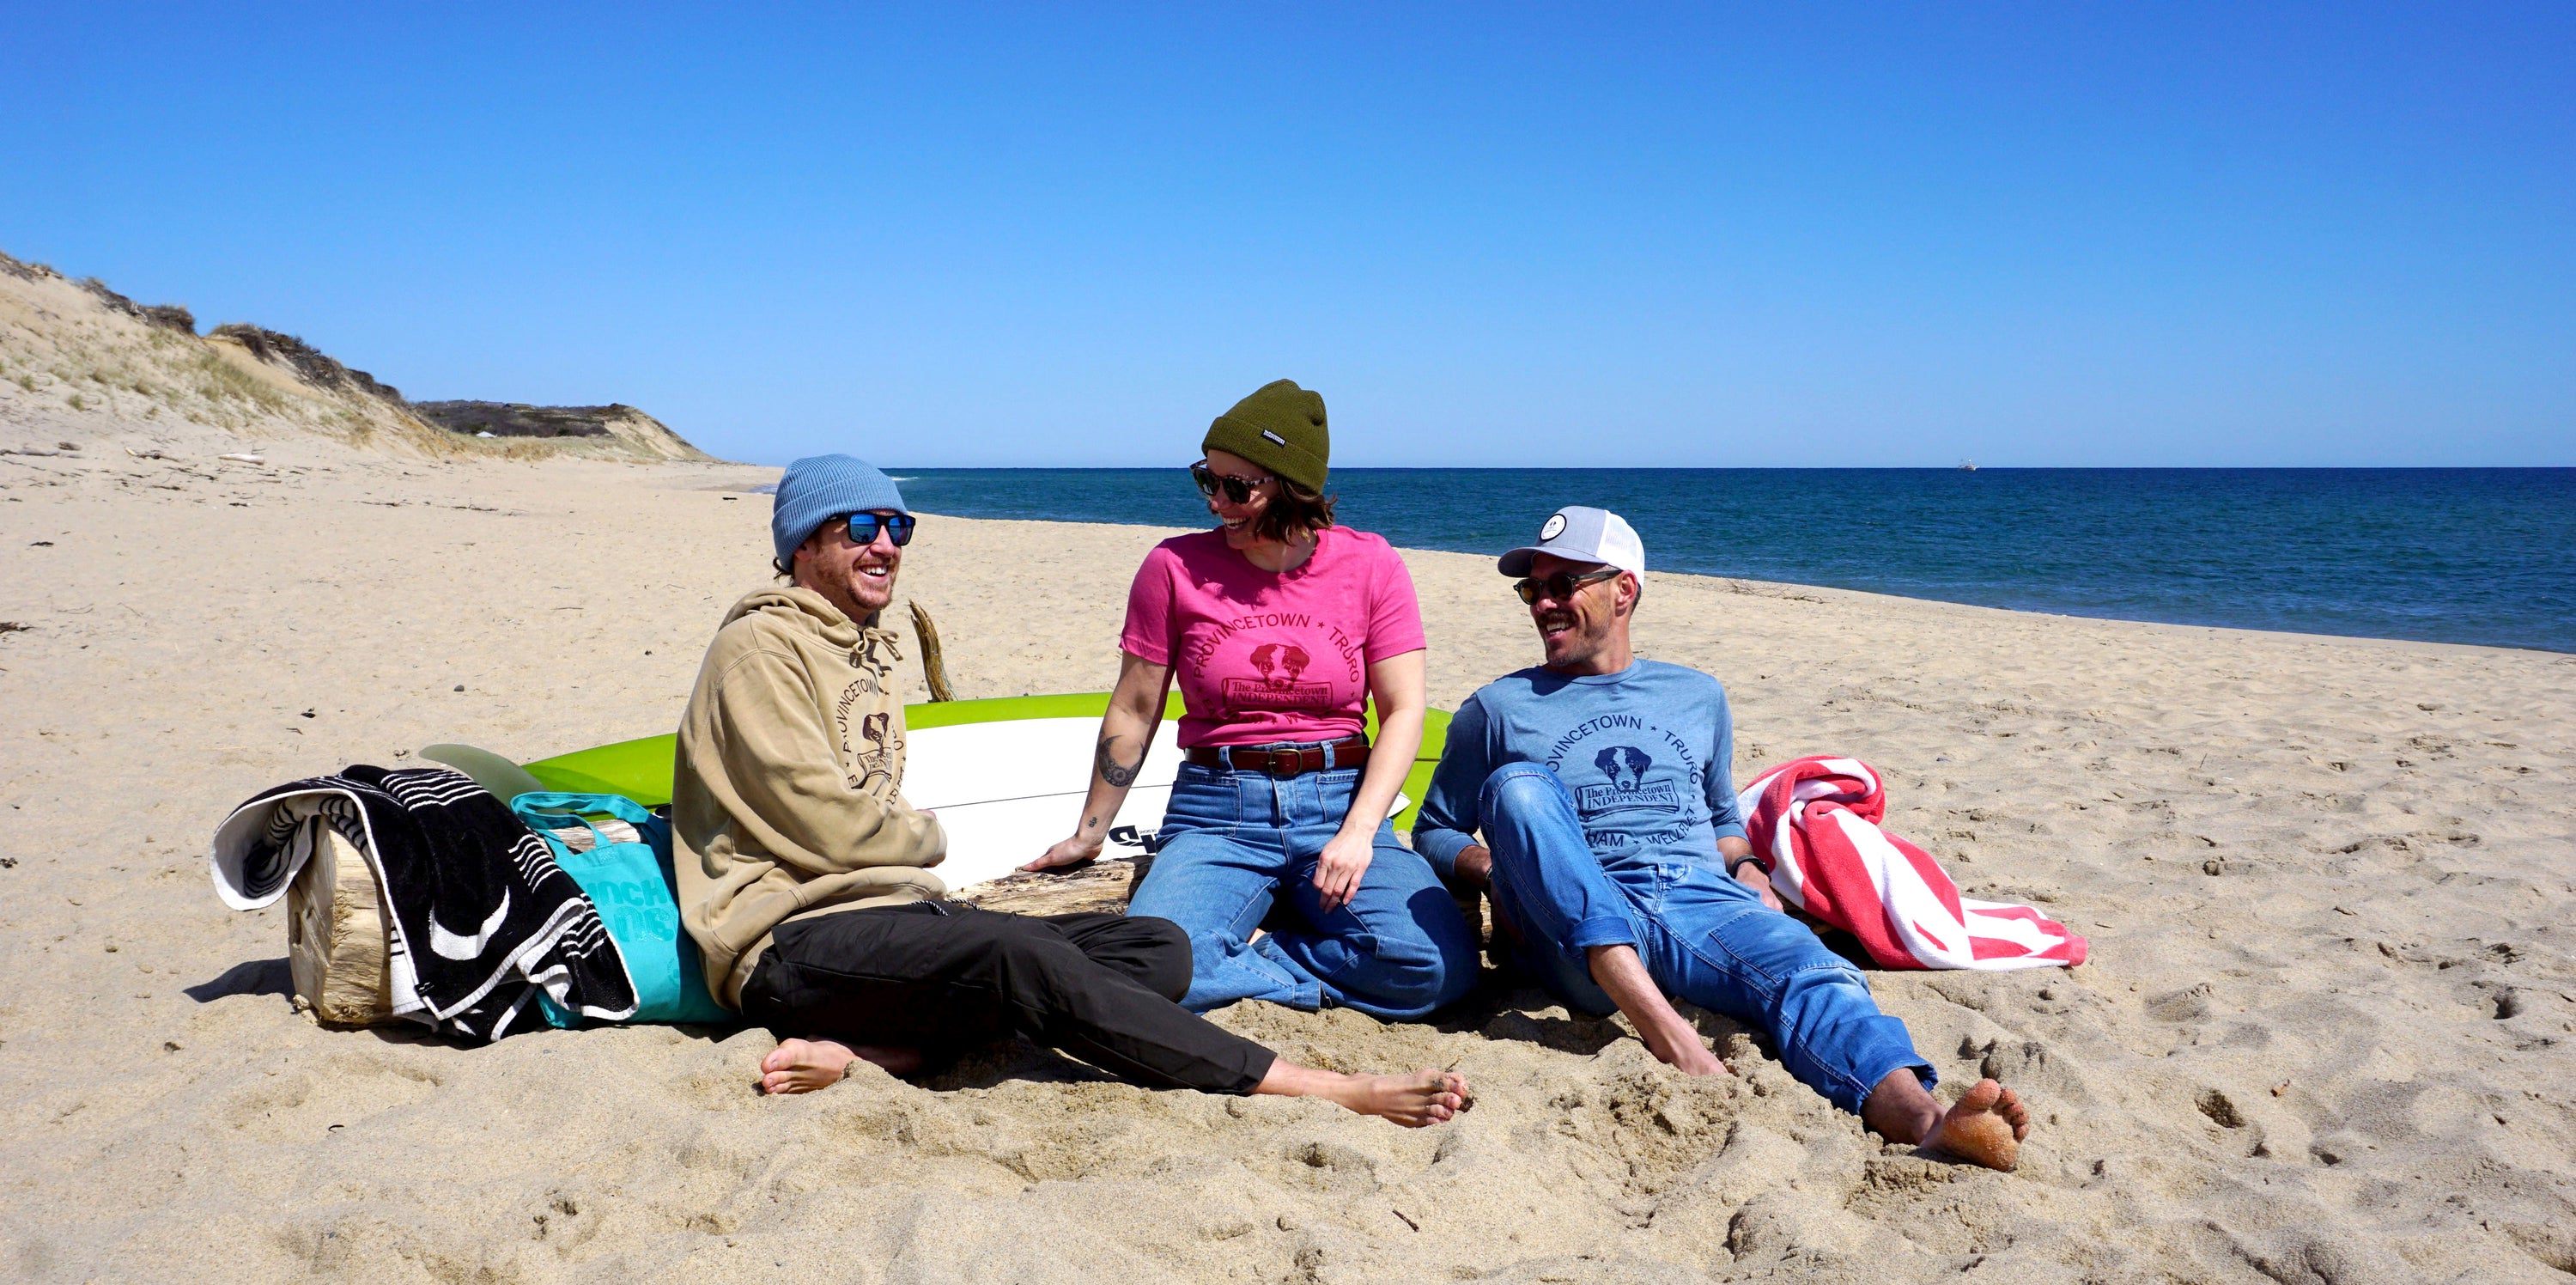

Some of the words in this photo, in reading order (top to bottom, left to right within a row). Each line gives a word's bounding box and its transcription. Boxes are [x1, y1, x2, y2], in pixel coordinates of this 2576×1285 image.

[1193, 612, 1311, 679] PROVINCETOWN
[1327, 625, 1361, 684] TRURO
[1232, 681, 1251, 693] The
[1254, 683, 1328, 696] Proncetown
[1231, 692, 1328, 705] INDEPENDENT
[835, 678, 879, 753] POVINCETOWN
[1546, 714, 1642, 772] OVINCETOWN
[1664, 730, 1698, 785] TRURO
[1585, 789, 1604, 799] The
[1605, 783, 1672, 796] Proncetown
[1587, 792, 1675, 809] INDEPENDENT
